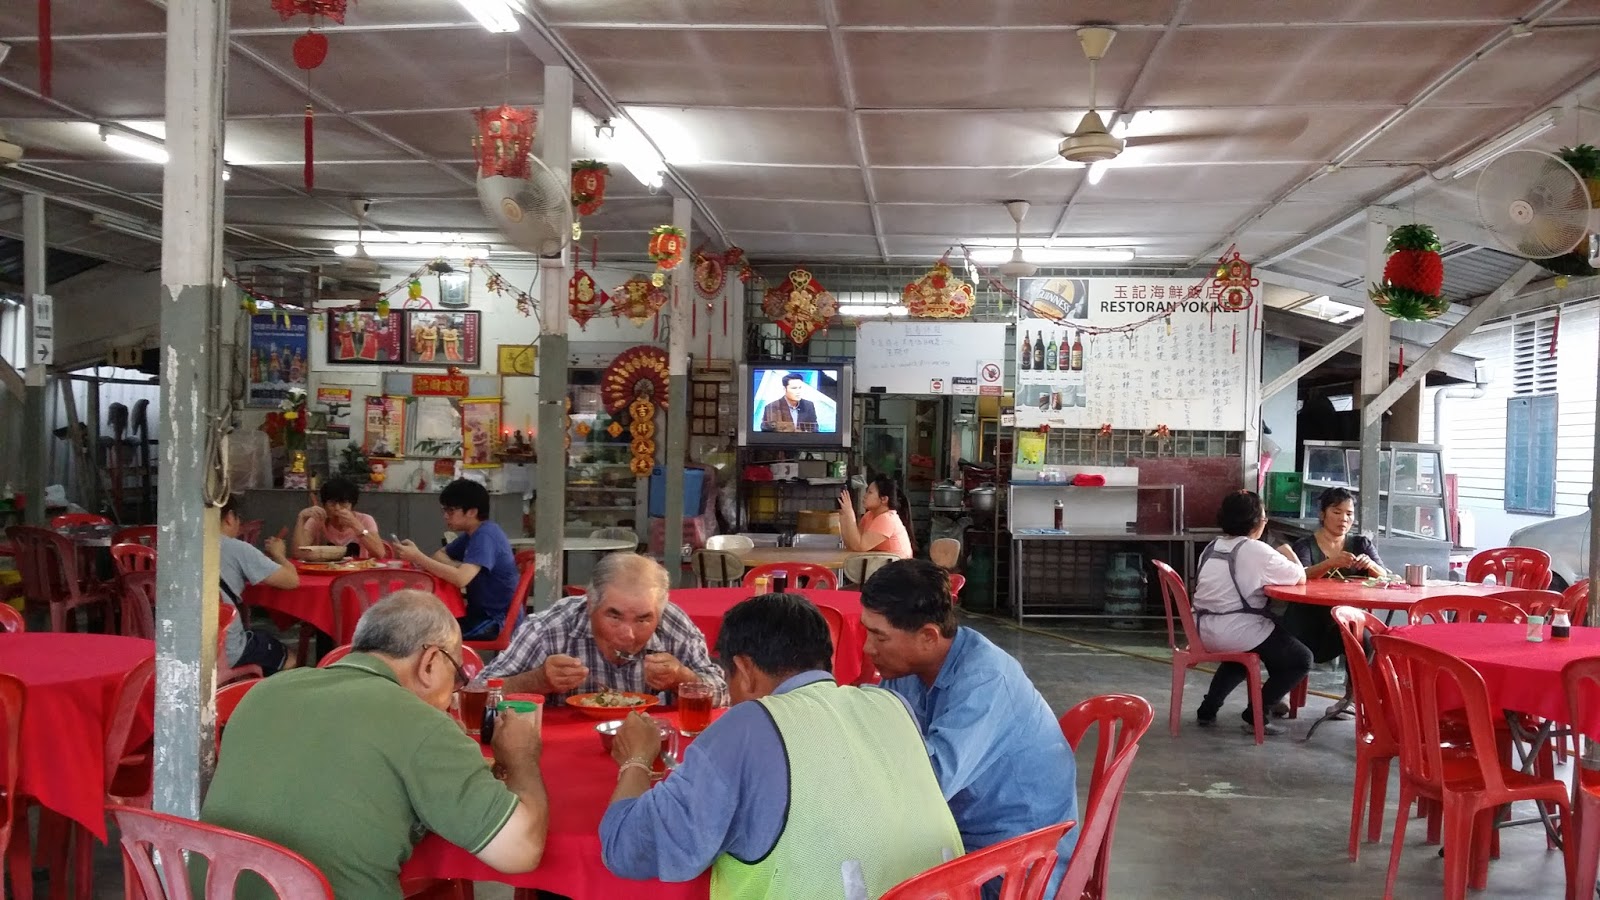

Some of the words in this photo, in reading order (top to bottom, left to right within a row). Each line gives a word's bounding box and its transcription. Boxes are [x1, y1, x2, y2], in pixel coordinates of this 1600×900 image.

[1037, 289, 1071, 314] GUINNESS
[1100, 301, 1176, 313] RESTORAN
[1180, 301, 1209, 313] YOK
